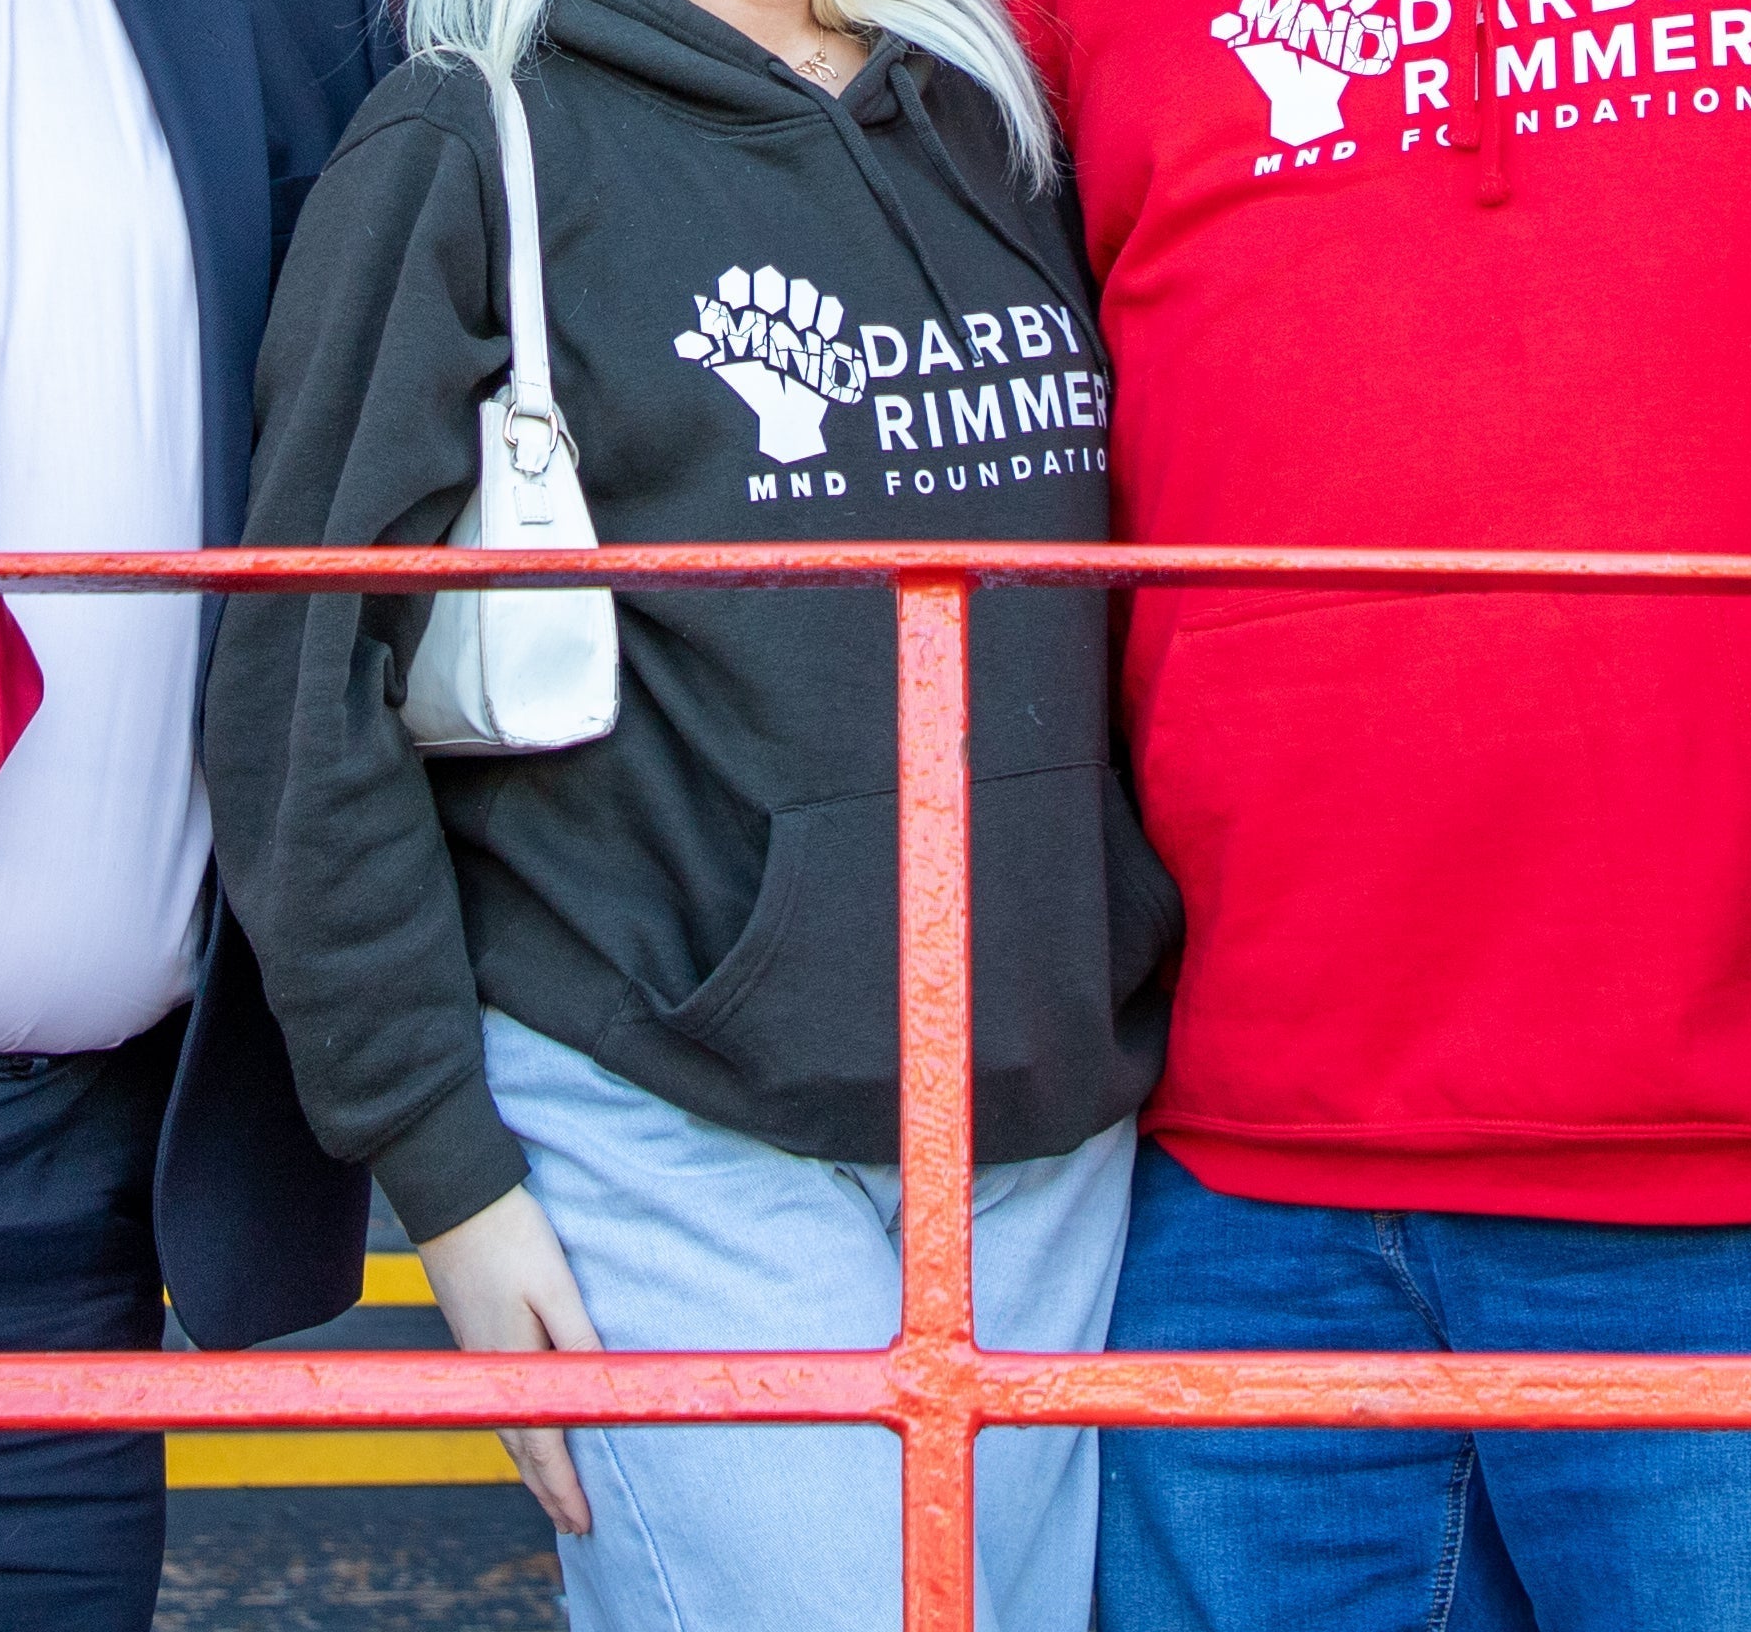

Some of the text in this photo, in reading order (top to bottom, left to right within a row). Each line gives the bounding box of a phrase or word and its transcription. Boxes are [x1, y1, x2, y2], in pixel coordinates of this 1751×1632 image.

[1254, 140, 1357, 177] MND
[859, 304, 1080, 378] DARBY
[874, 370, 1108, 451] RIMMER
[748, 470, 847, 502] MND
